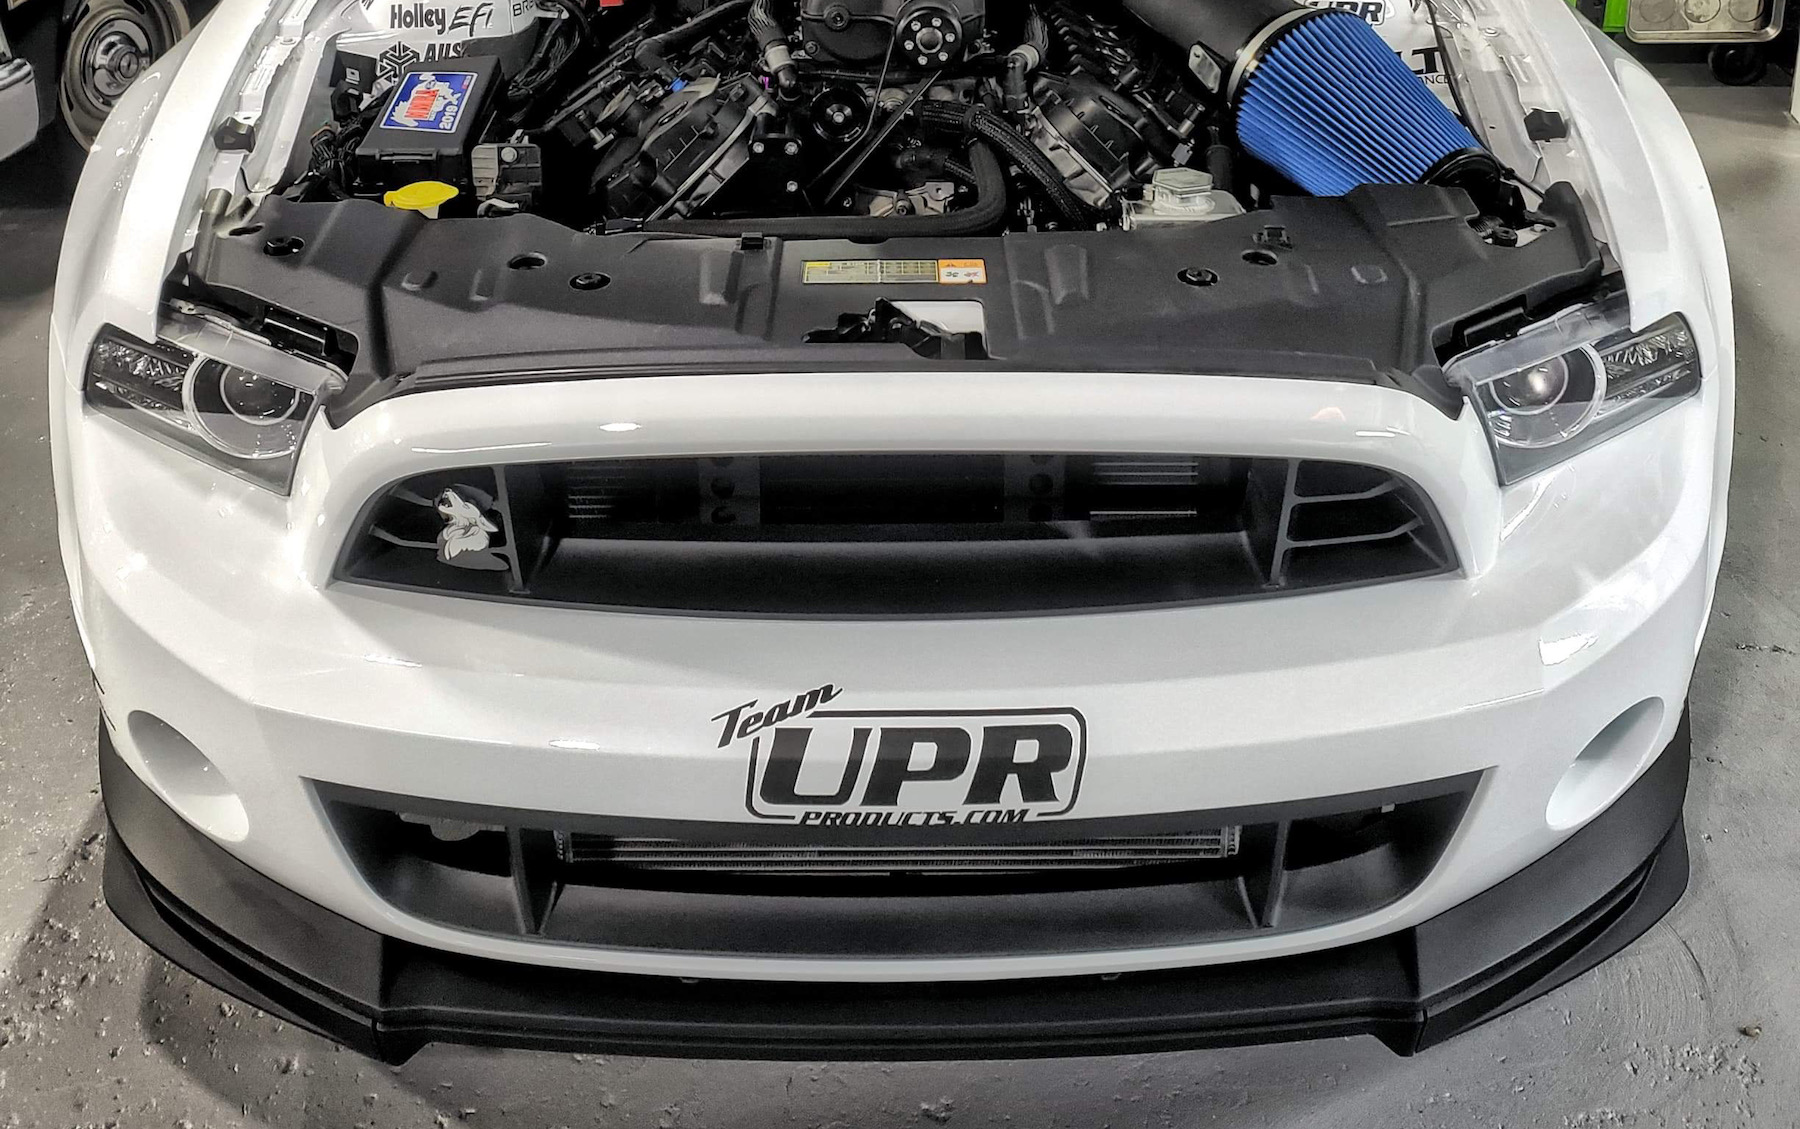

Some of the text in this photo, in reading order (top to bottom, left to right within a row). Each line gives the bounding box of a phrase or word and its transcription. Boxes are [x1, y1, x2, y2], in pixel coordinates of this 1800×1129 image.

[389, 2, 446, 34] Holley
[438, 104, 459, 130] 2019
[711, 683, 842, 749] Team
[759, 723, 1074, 807] UPR
[798, 808, 1031, 827] PRODUCTS.COM
